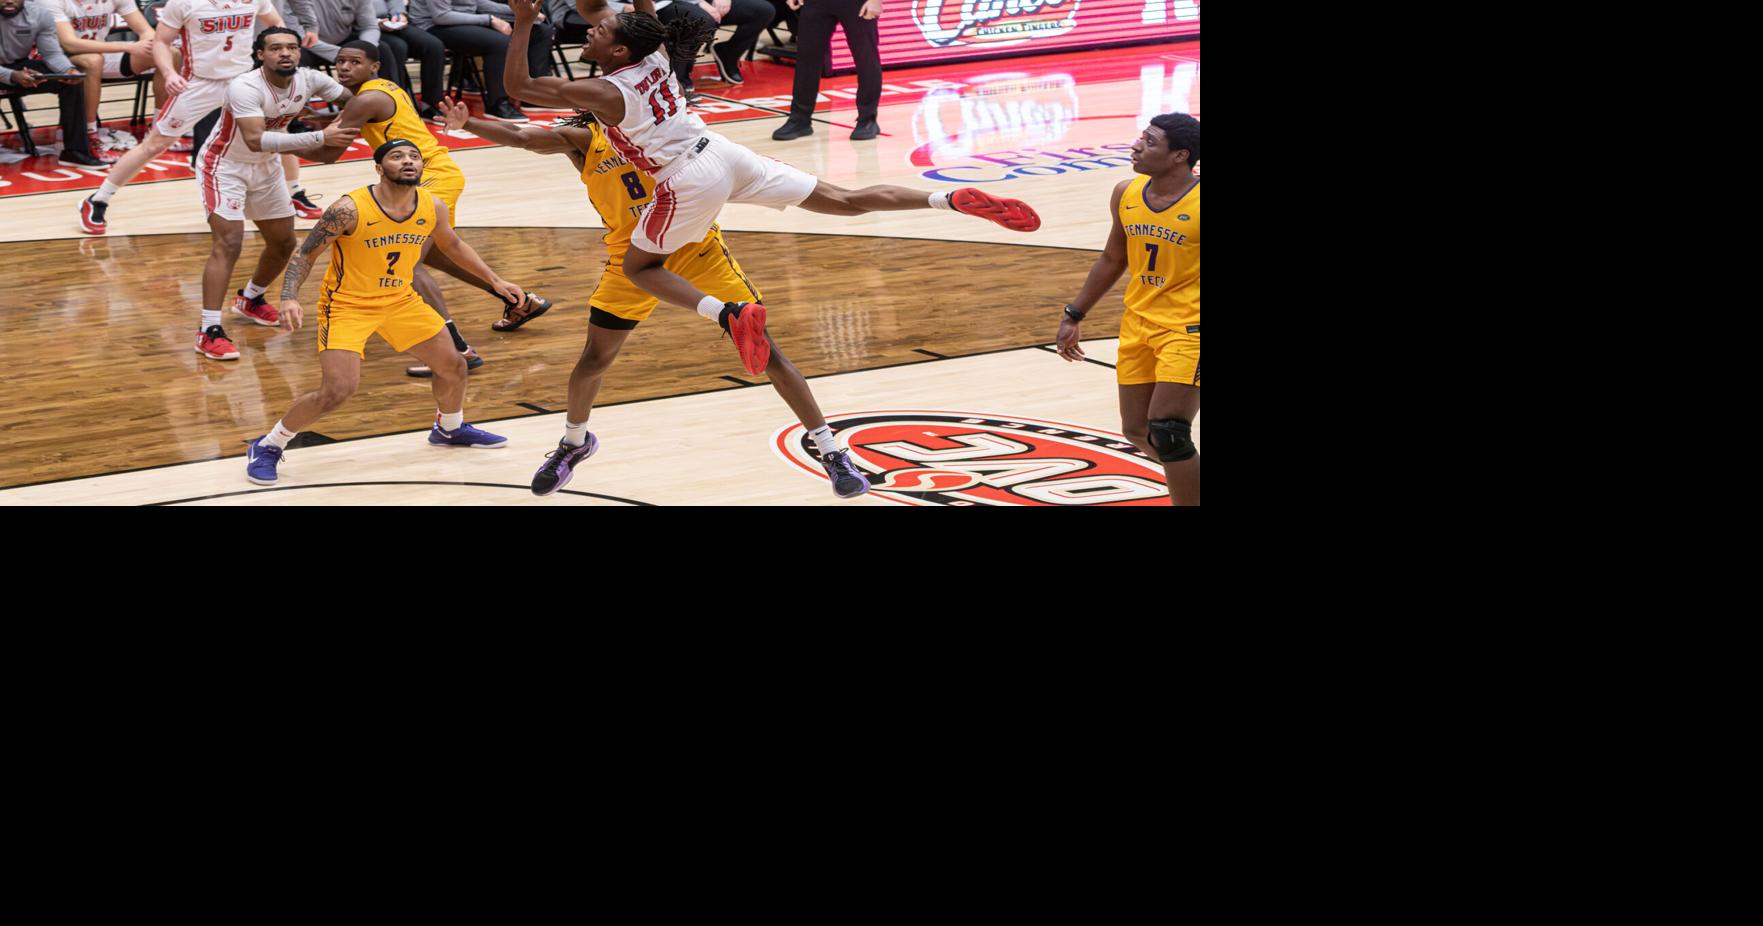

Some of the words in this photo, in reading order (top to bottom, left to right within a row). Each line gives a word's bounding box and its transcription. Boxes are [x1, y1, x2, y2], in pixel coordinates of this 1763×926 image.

[200, 13, 254, 34] SIUE
[223, 35, 234, 52] 5
[648, 79, 678, 126] 11
[621, 171, 647, 200] 8
[1125, 223, 1187, 246] TENNESSEE
[387, 251, 400, 275] 2
[1145, 243, 1159, 272] 7
[1141, 274, 1167, 289] TECH
